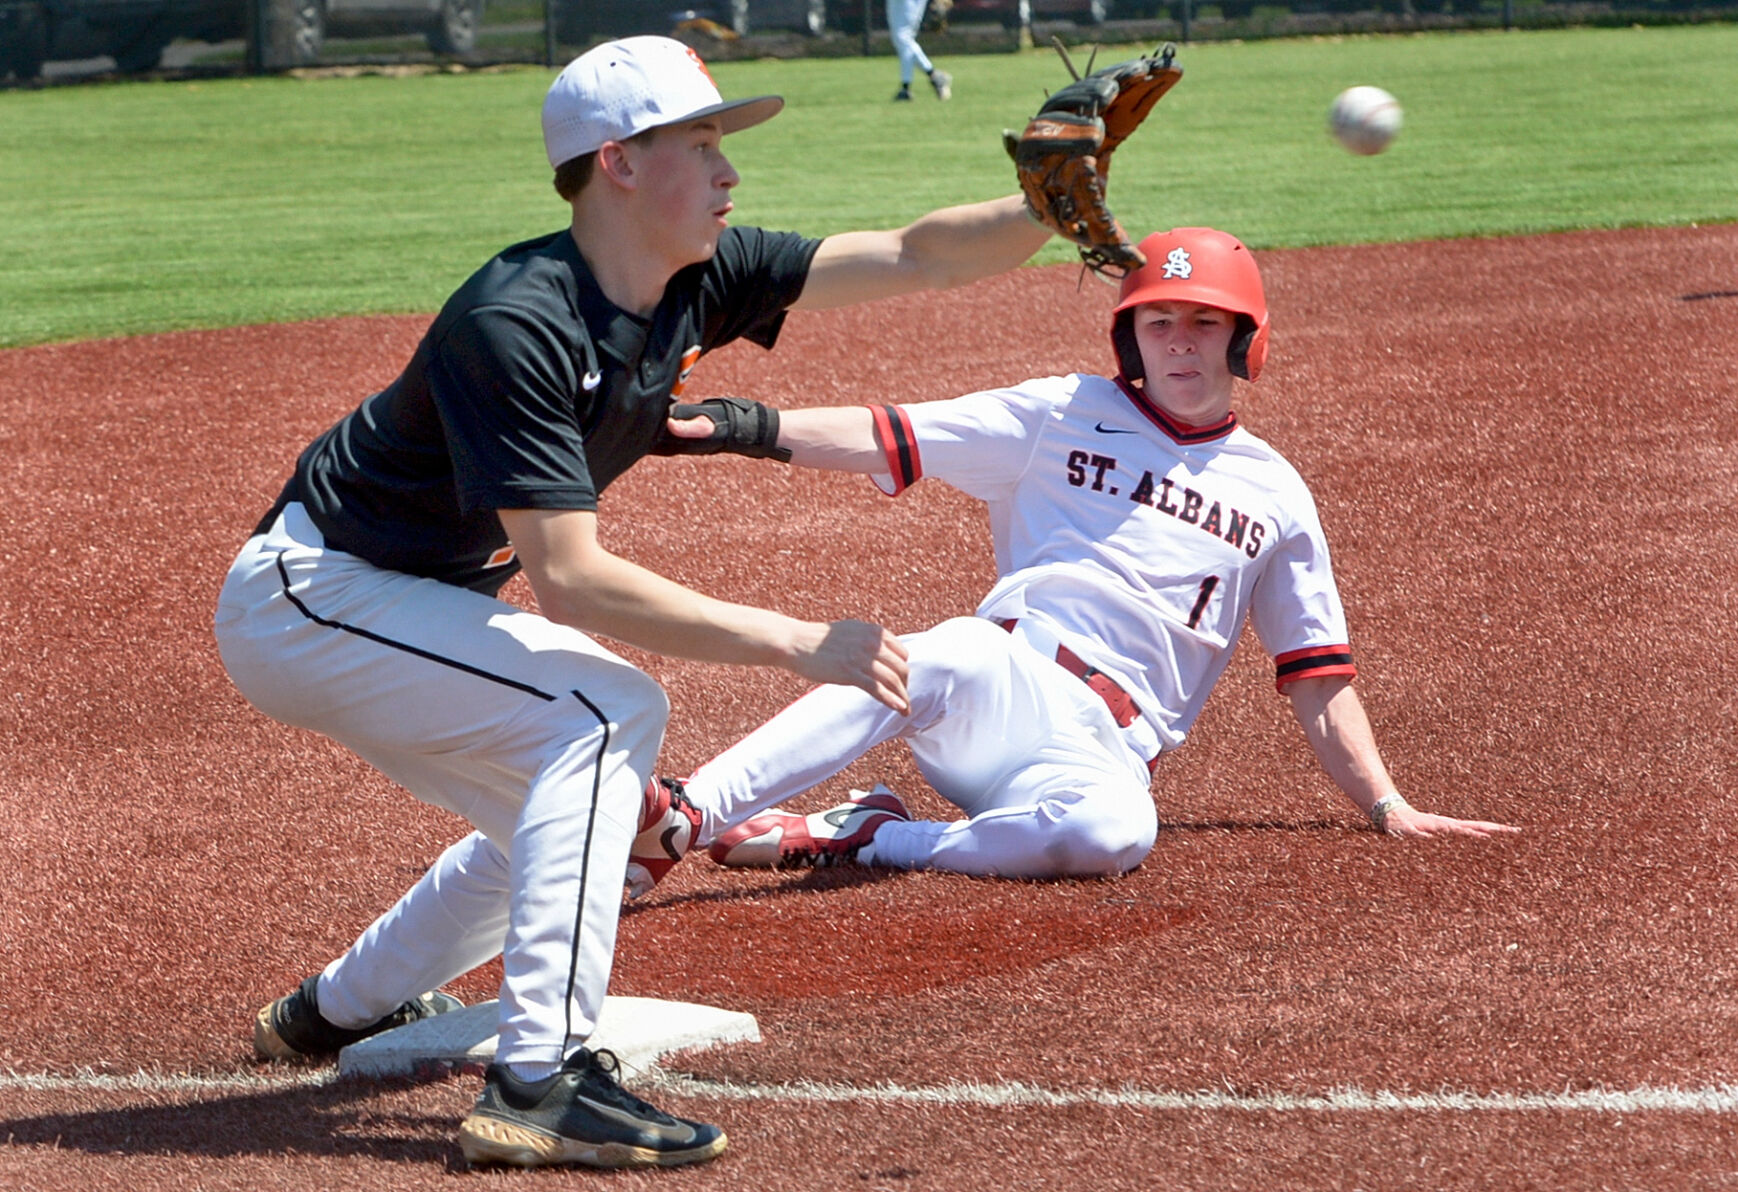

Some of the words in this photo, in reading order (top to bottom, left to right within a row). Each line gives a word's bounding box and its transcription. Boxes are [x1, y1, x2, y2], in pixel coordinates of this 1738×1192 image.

[1067, 450, 1119, 496] ST.
[1130, 470, 1265, 559] ALBANS
[1185, 575, 1220, 630] 1
